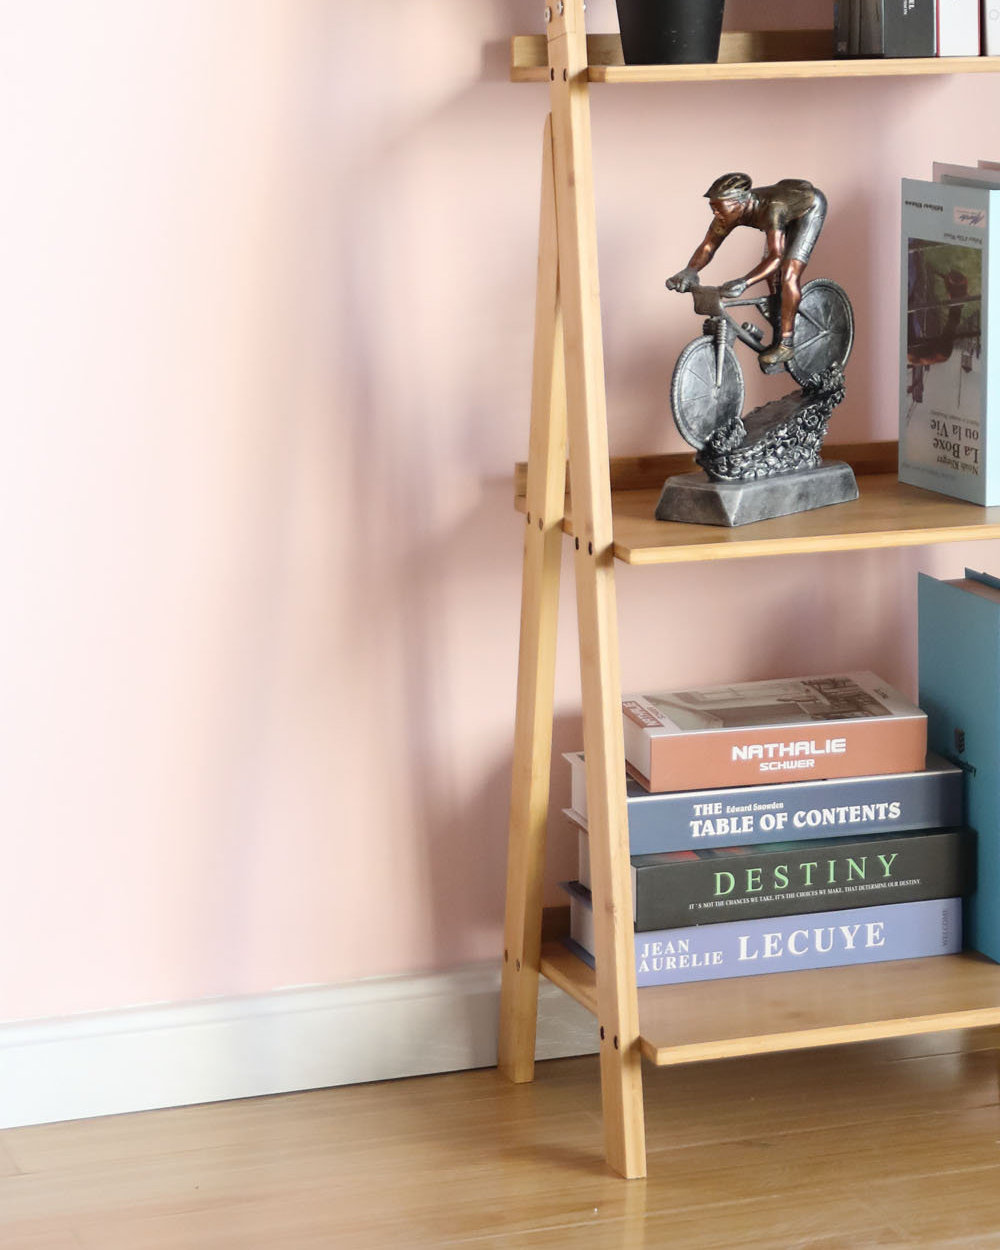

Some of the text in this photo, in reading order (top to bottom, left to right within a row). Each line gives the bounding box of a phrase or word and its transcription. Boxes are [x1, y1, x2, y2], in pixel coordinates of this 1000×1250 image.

[930, 419, 979, 441] ou la Vie
[932, 438, 979, 463] La Boxe
[731, 738, 847, 761] NATHALIE
[759, 759, 815, 772] SCHWER
[689, 801, 902, 838] TABLE OF CONTENTS
[693, 801, 784, 817] THE Edward Snowden
[713, 853, 899, 896] DESTINY
[725, 898, 750, 907] CHANCES
[796, 890, 818, 898] CHOICES
[858, 882, 887, 891] DETERMINE
[887, 880, 898, 888] OUR
[899, 878, 921, 887] DESTINY
[641, 938, 690, 959] JEAN
[737, 922, 886, 961] LECUYE
[638, 951, 723, 973] AURELIE
